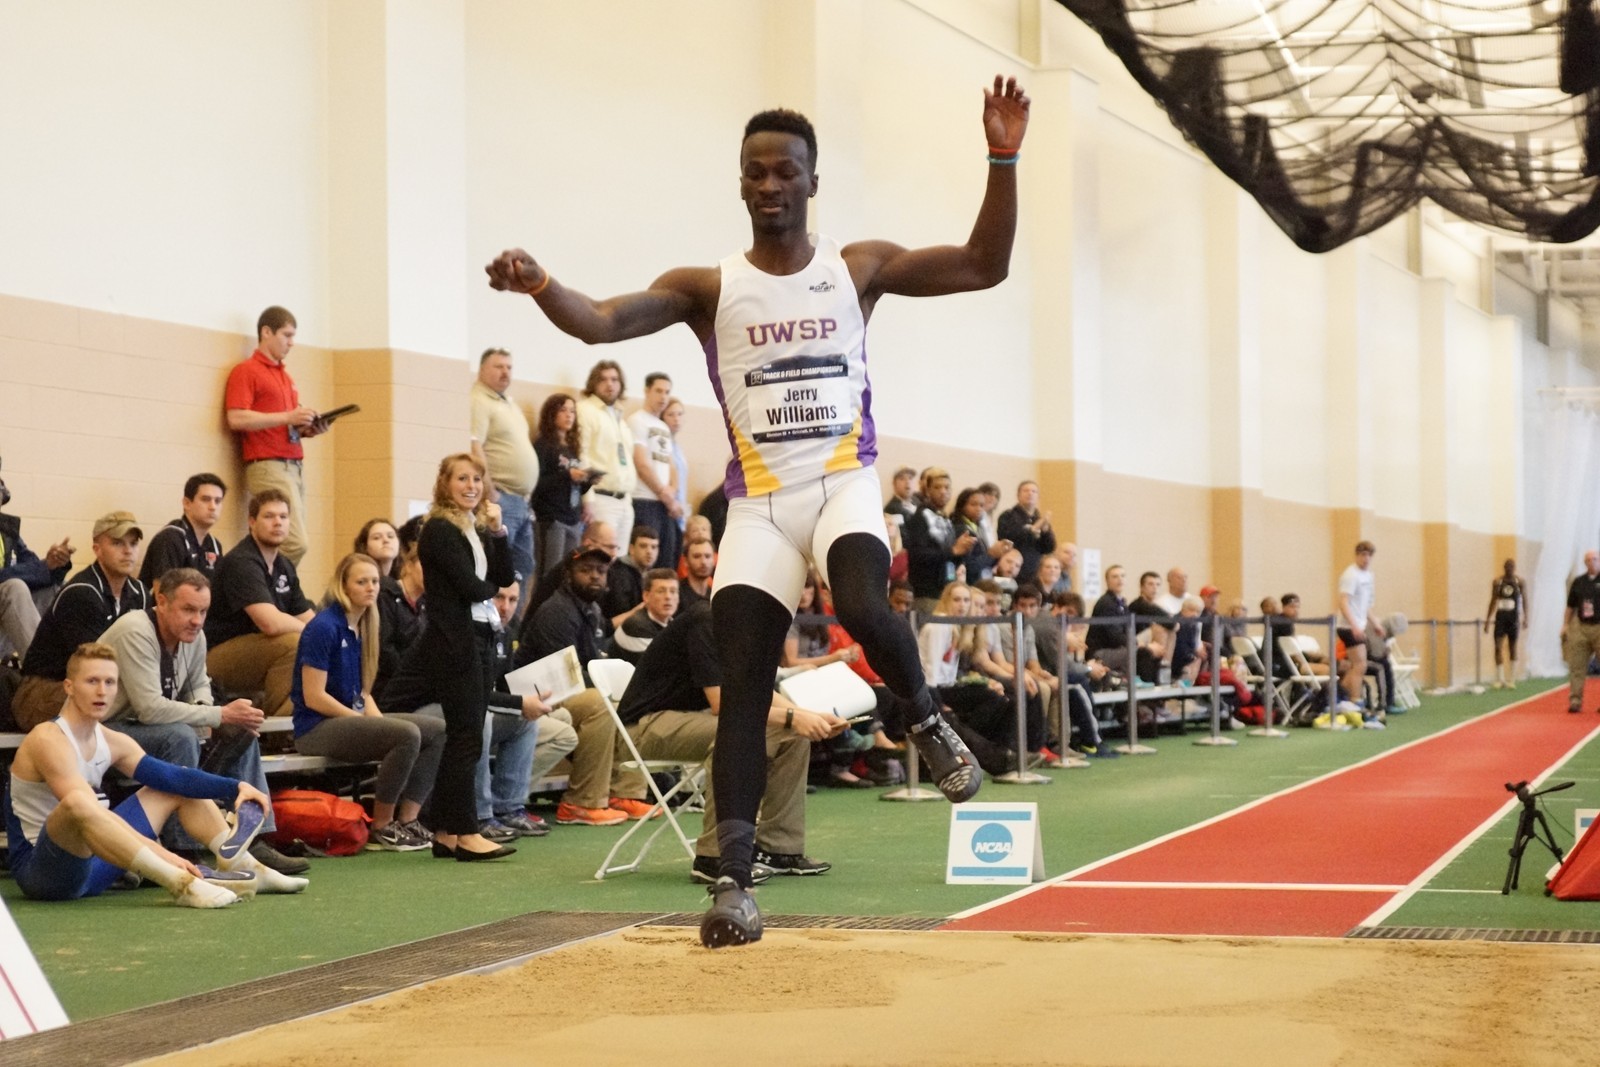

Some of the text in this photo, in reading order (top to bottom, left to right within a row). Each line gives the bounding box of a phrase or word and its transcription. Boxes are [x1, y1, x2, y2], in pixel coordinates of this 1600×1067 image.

[745, 318, 837, 347] UWSP
[763, 371, 780, 380] TRACK
[785, 369, 800, 378] FIELD
[801, 365, 843, 376] CHAMPIONSHIPS
[784, 388, 818, 402] Jerry
[766, 405, 837, 426] Williams
[974, 842, 1012, 853] NCAA
